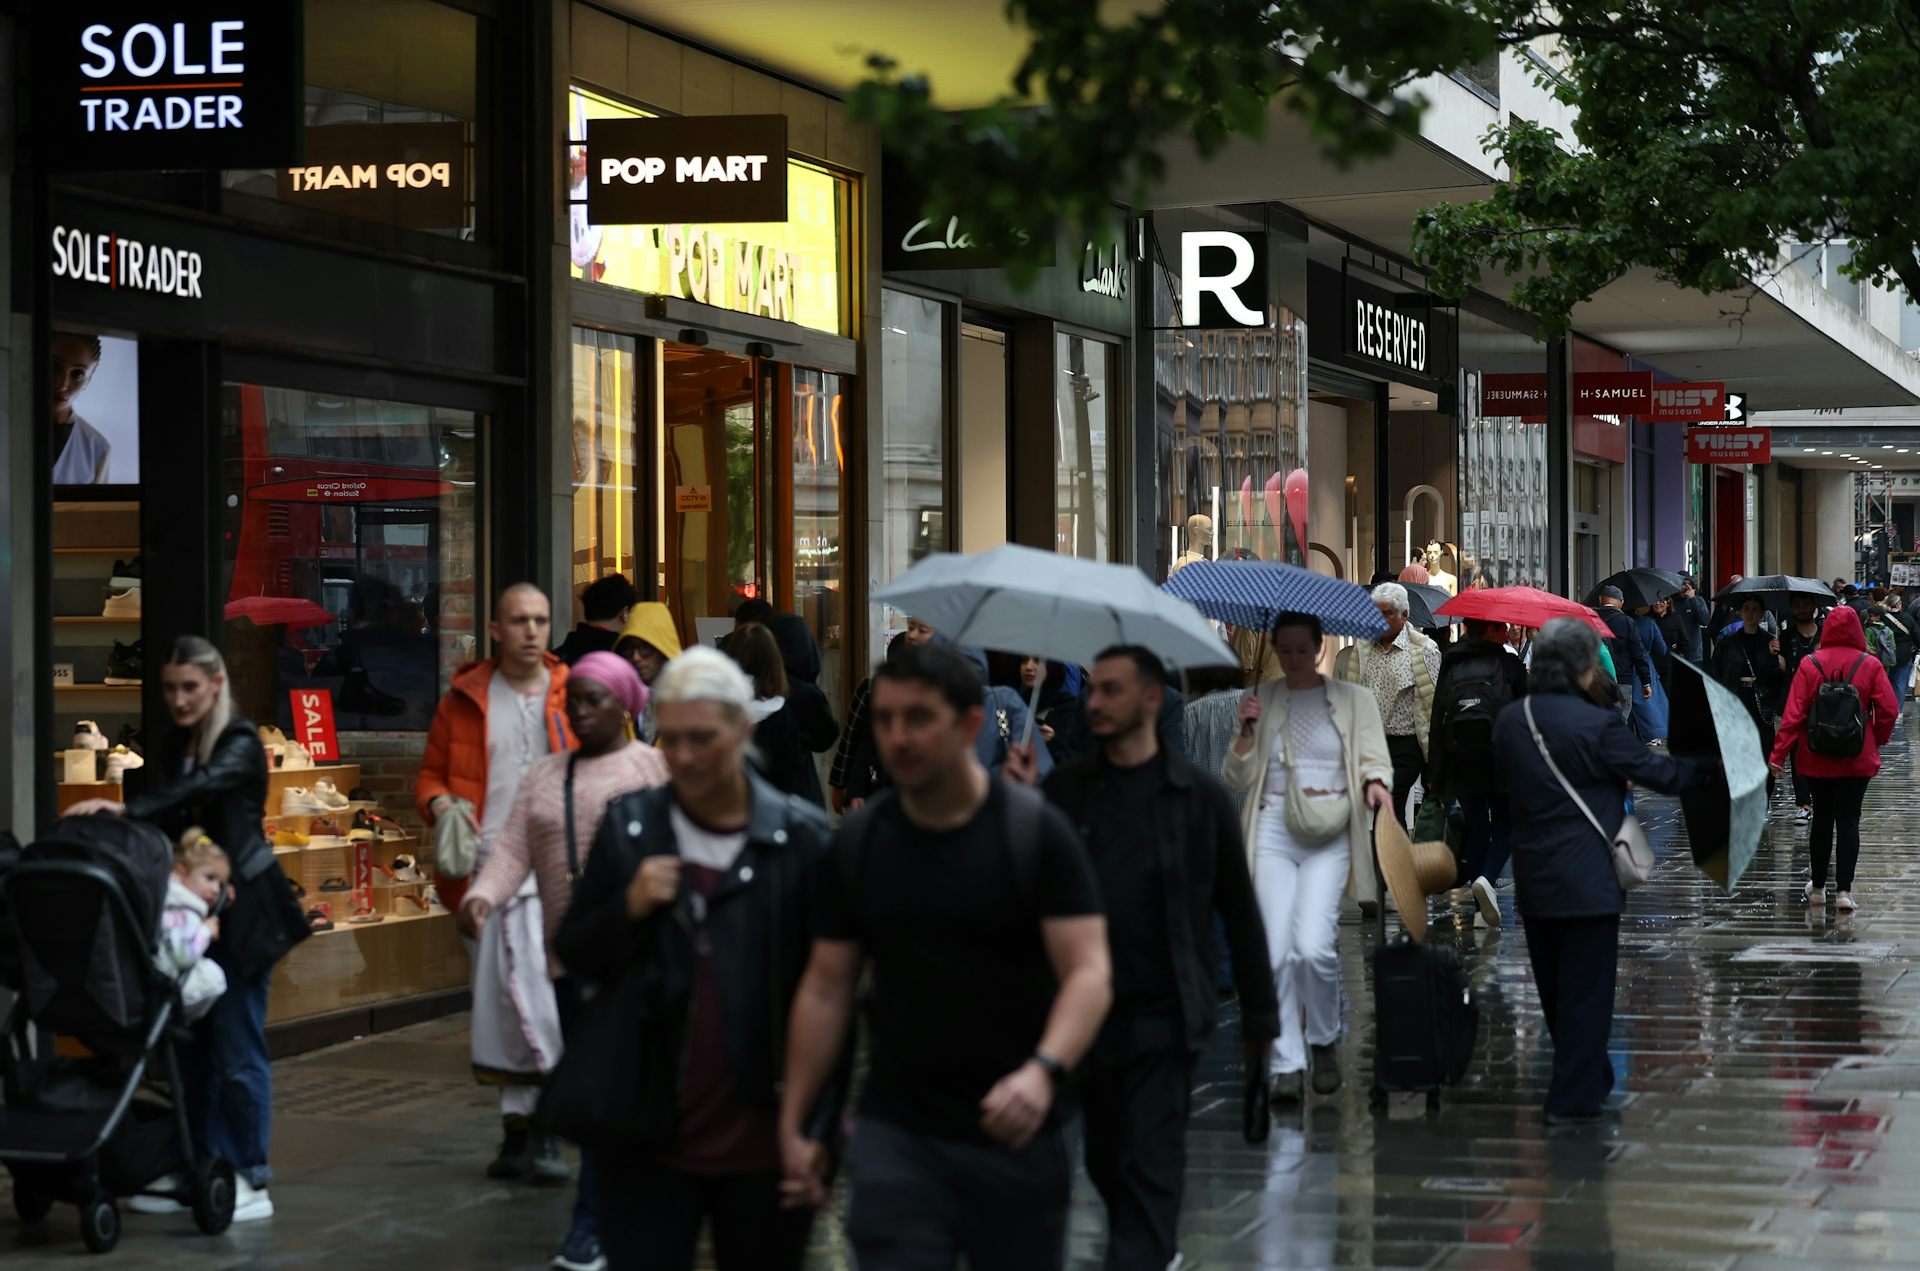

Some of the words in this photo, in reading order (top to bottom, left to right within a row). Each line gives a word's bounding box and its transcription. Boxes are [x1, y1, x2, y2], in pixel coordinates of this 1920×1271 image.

[80, 20, 245, 79] SOLE
[80, 94, 243, 132] TRADER
[601, 157, 666, 185] POP
[675, 155, 768, 183] MART
[52, 225, 111, 284] SOLE
[116, 238, 203, 299] TRADER
[901, 215, 1030, 252] Clas
[668, 224, 724, 305] POP
[734, 240, 800, 324] MART
[1181, 230, 1265, 327] R
[1357, 298, 1426, 372] RESERVED
[1659, 408, 1701, 416] museum
[301, 693, 327, 757] SALE
